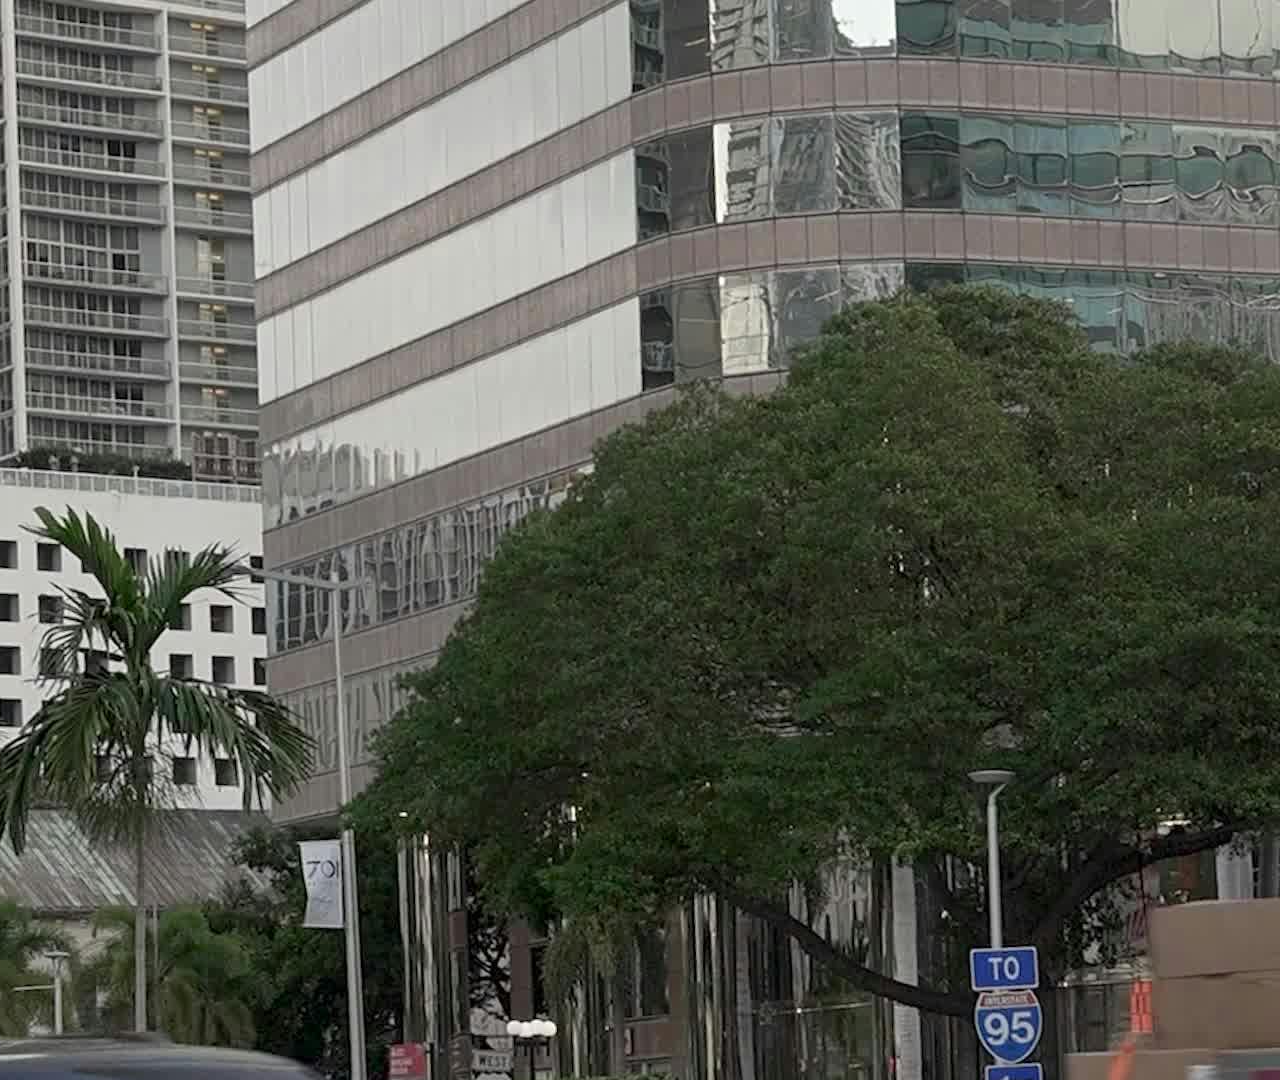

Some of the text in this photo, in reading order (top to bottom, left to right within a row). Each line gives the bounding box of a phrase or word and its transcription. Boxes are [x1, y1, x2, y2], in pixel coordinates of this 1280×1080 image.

[988, 956, 1020, 981] TO
[983, 1012, 1035, 1045] 95
[479, 1056, 507, 1067] WEST
